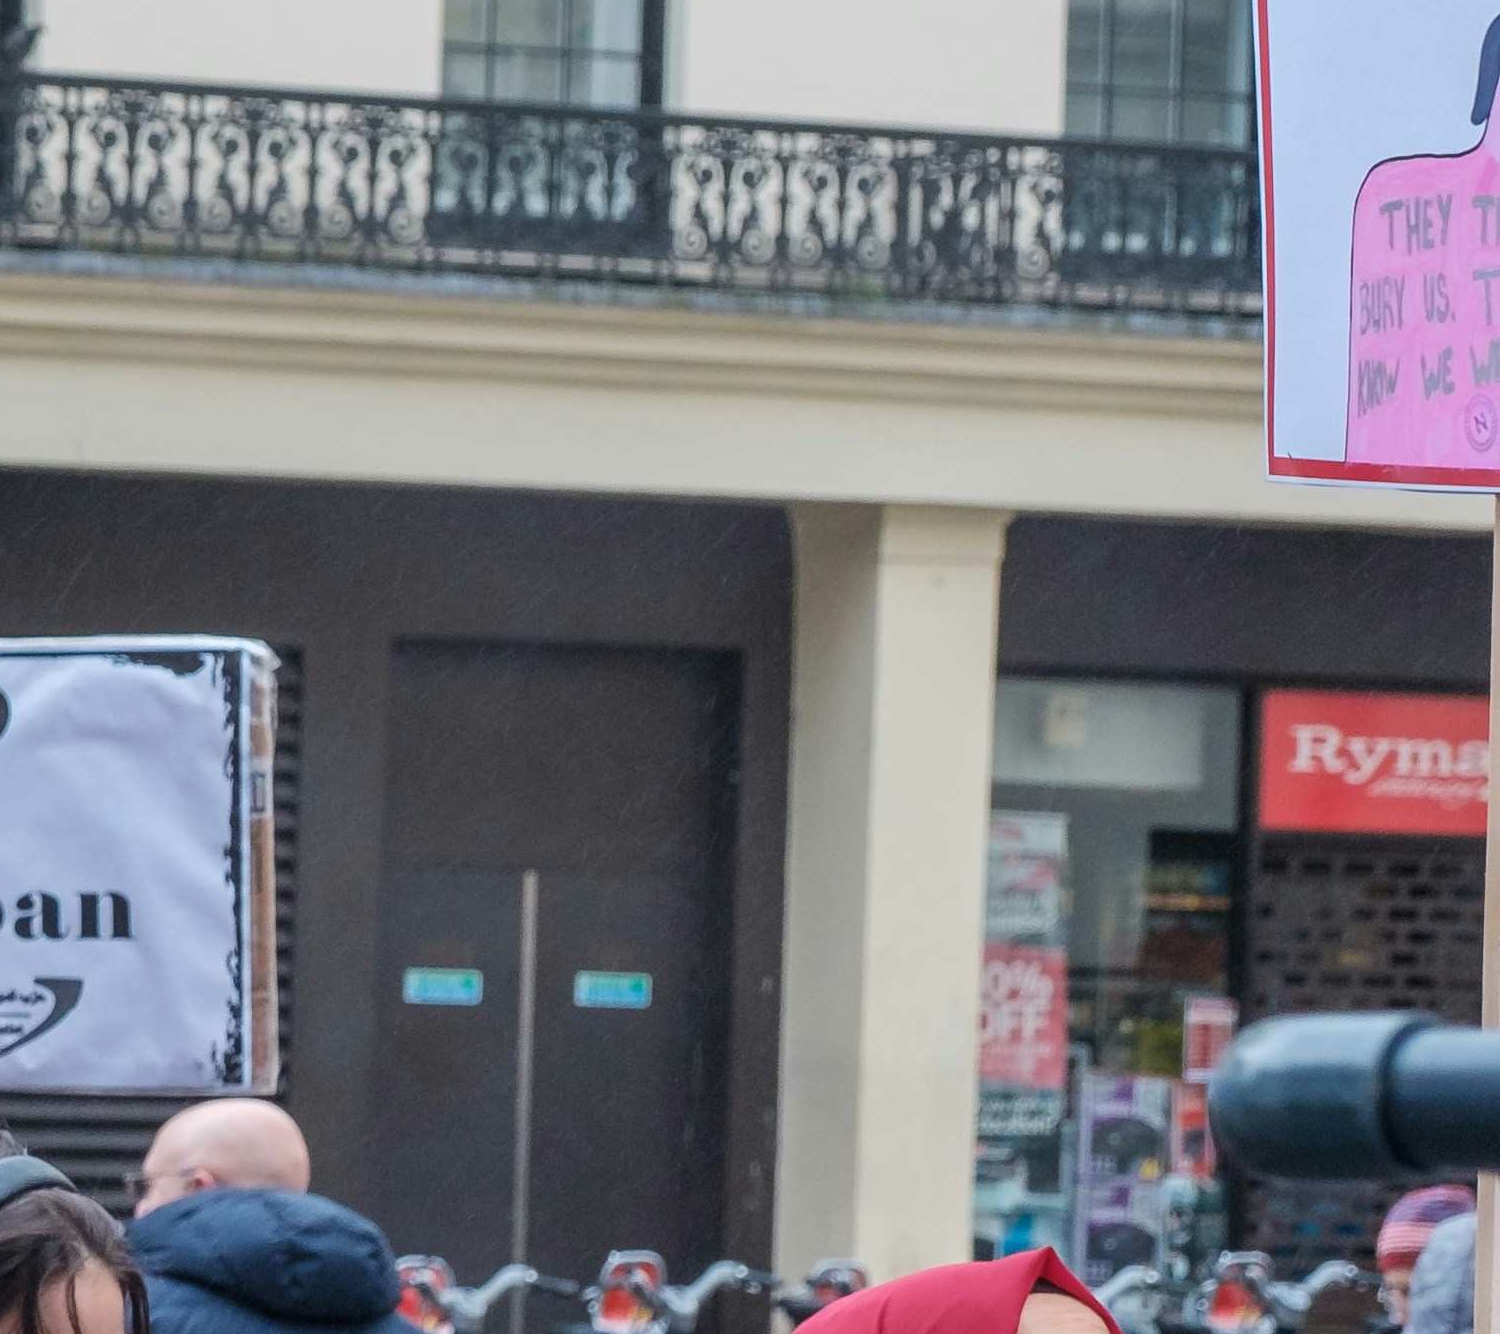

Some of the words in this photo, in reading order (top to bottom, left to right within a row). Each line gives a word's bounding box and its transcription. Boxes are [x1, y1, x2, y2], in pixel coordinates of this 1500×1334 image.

[1379, 193, 1453, 256] THEY
[1359, 274, 1405, 335] BURY
[1423, 272, 1456, 324] US.
[1421, 346, 1456, 400] WE
